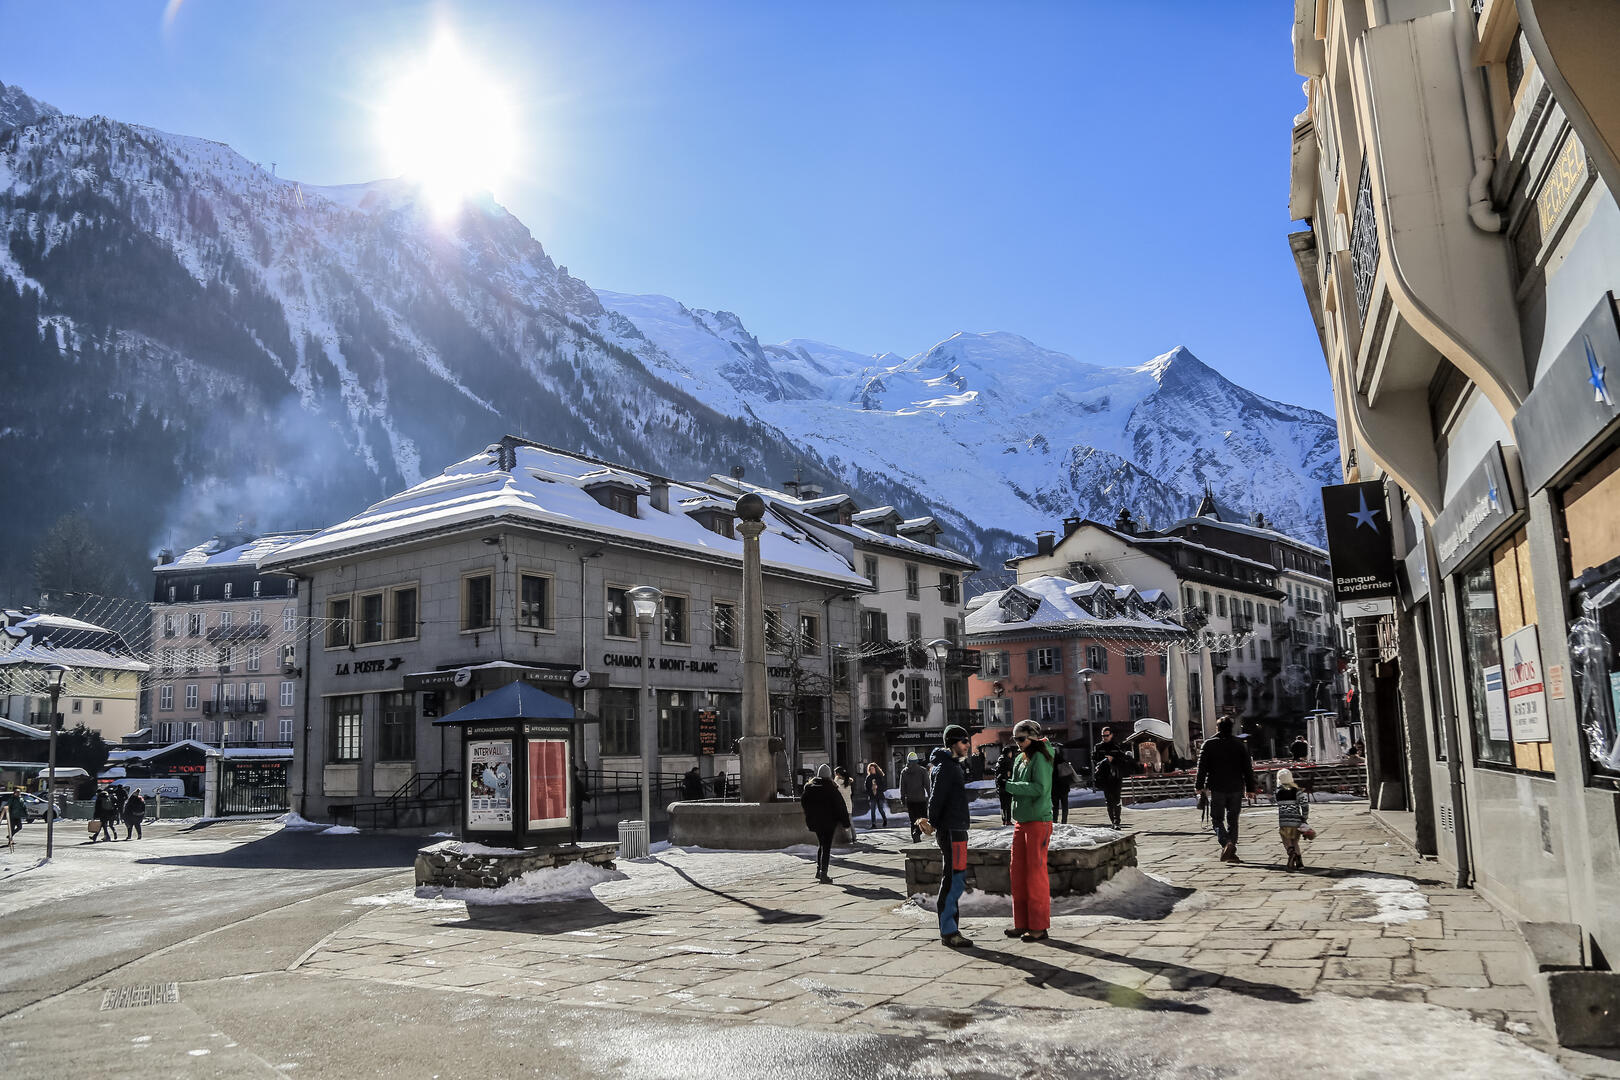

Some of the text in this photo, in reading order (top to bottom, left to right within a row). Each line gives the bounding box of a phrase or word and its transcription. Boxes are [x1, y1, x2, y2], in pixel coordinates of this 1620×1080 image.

[1336, 575, 1376, 585] Banque
[1337, 581, 1393, 593] Laydernier
[336, 659, 385, 676] LA POSTE
[603, 653, 719, 674] CHAMOX MONT-BLANC
